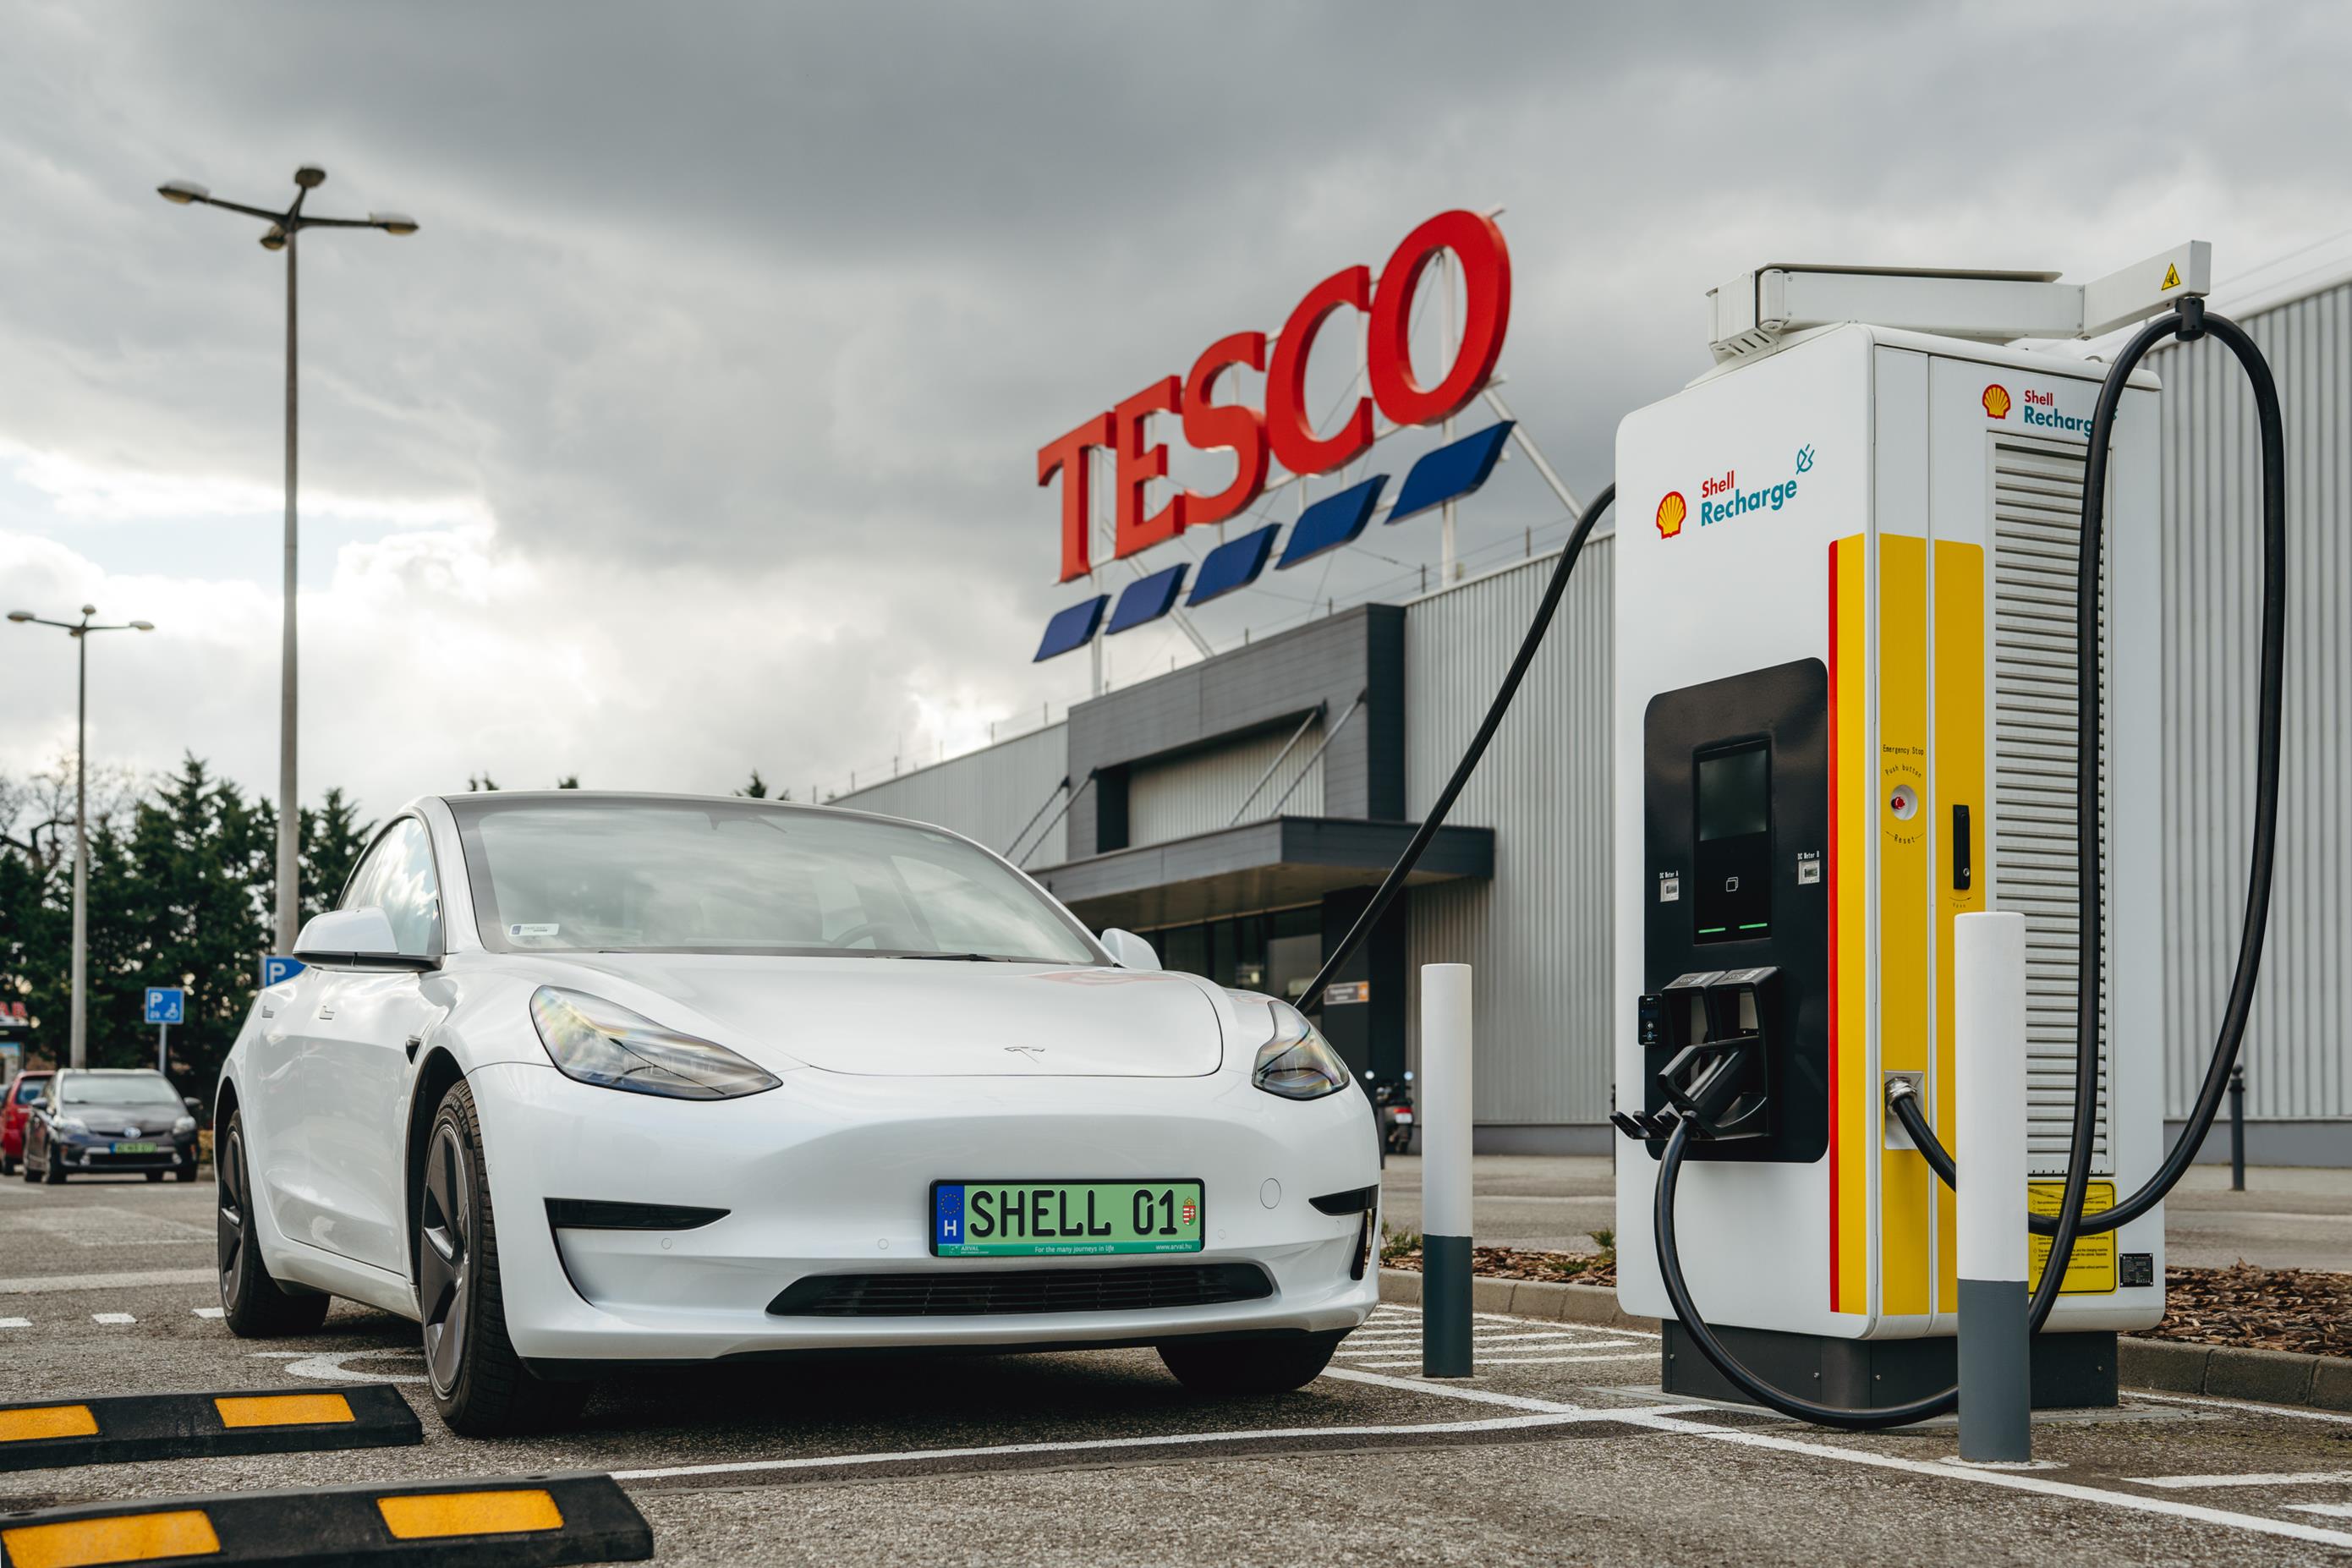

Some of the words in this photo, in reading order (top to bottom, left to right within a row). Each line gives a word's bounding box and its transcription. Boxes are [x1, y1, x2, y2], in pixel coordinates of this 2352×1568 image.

[1038, 209, 1511, 583] TESCO
[2024, 390, 2053, 407] Shell
[2024, 405, 2095, 438] Recharg
[1702, 470, 1735, 498] Shell
[1701, 480, 1797, 527] Recharge
[1883, 744, 1910, 755] Emergency
[1911, 747, 1924, 756] Stop
[1884, 765, 1899, 776] Push
[1902, 764, 1922, 778] button
[1894, 834, 1916, 844] Reset
[269, 962, 286, 984] P
[150, 992, 163, 1009] P
[969, 1189, 1111, 1237] SHELL
[1132, 1188, 1178, 1236] 01
[944, 1220, 957, 1237] H
